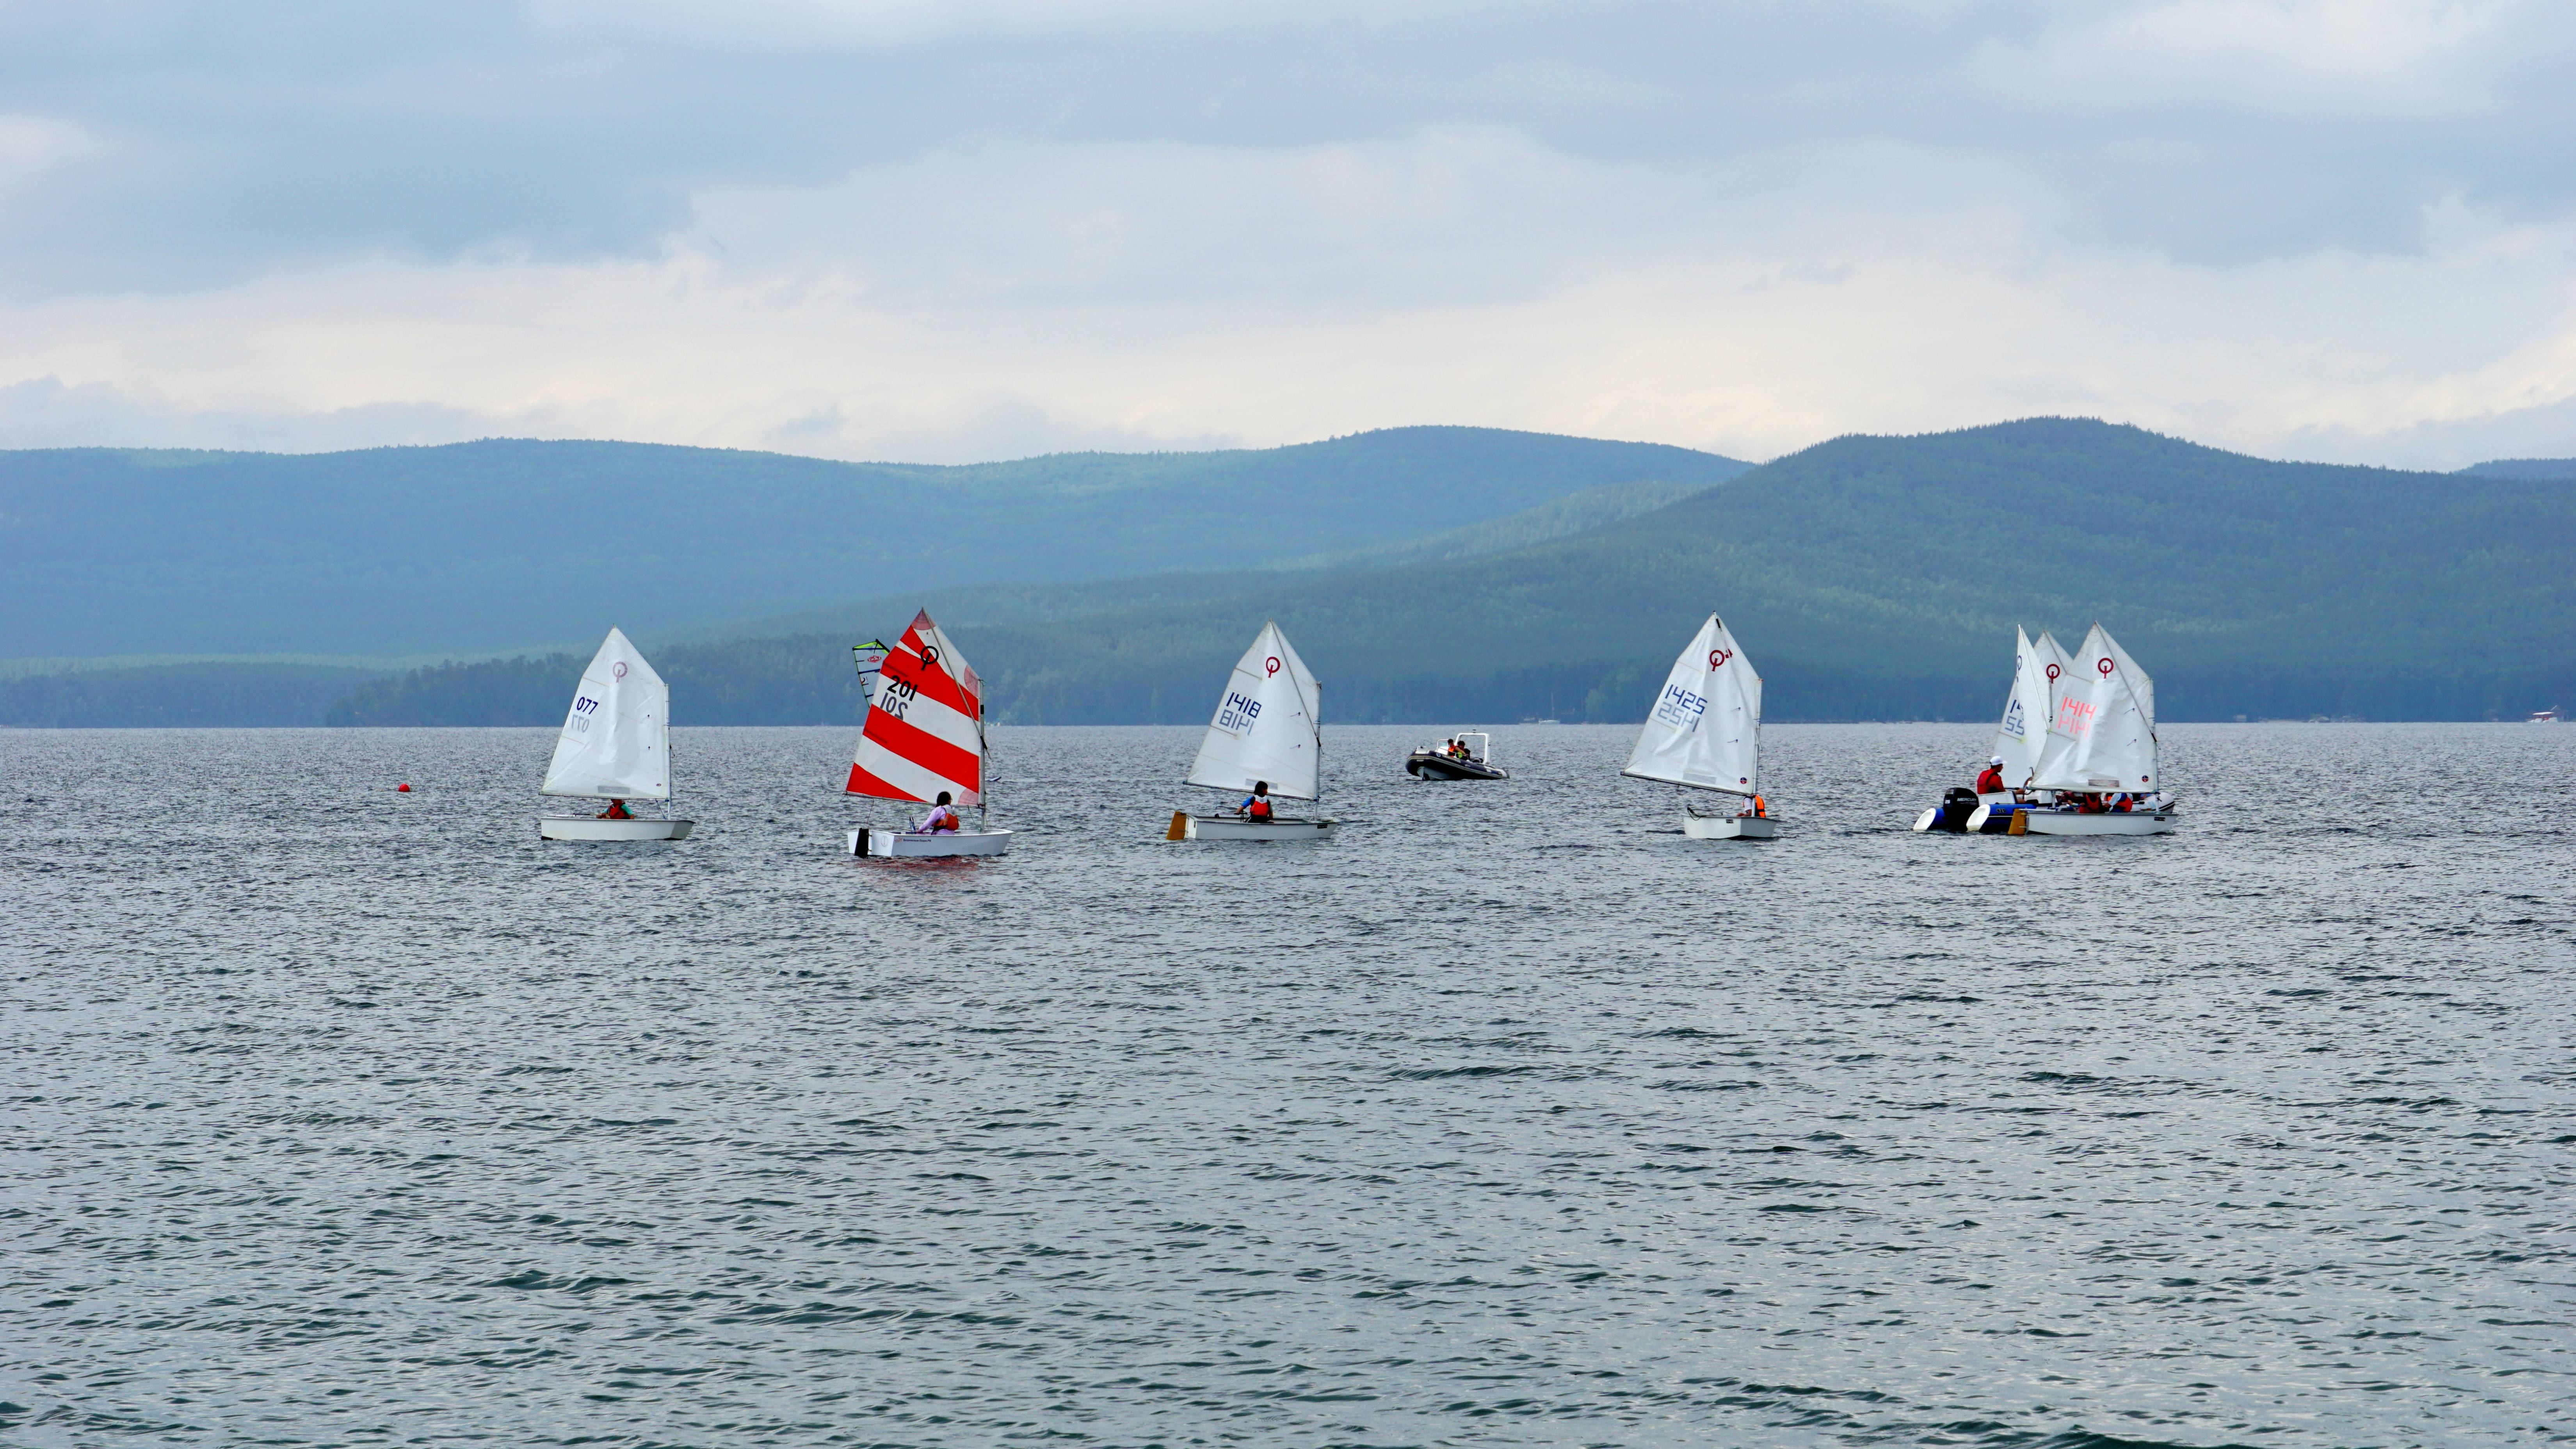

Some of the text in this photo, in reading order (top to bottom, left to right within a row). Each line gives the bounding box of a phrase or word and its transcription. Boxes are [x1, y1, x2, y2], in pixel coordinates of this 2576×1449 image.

[887, 675, 918, 702] 201
[1665, 684, 1708, 715] 1425
[576, 696, 599, 715] 077
[1226, 692, 1262, 719] 1418
[2061, 697, 2097, 720] 1414
